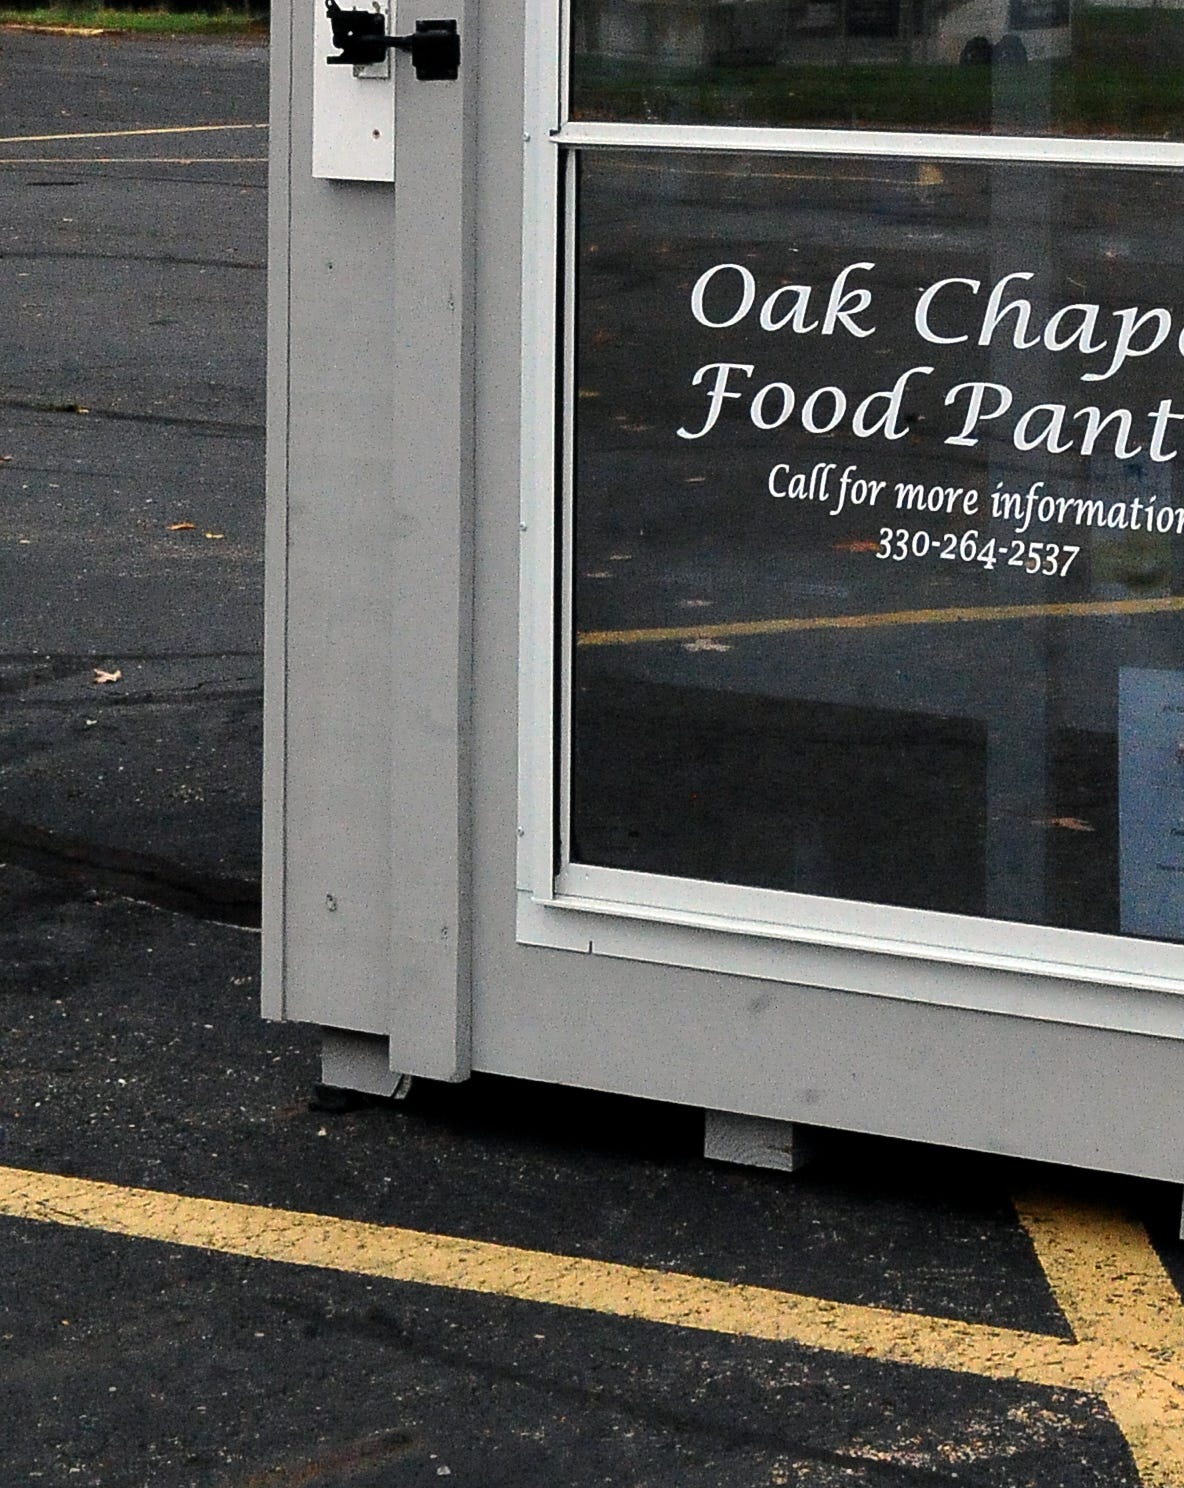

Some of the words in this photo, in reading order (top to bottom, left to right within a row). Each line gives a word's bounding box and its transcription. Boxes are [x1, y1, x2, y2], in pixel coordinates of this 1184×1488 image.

[690, 261, 876, 339] Oak
[676, 362, 934, 441] Food
[768, 463, 831, 502] Call
[829, 467, 888, 516] for
[895, 484, 980, 517] more
[875, 526, 1081, 577] 330-264-2537
